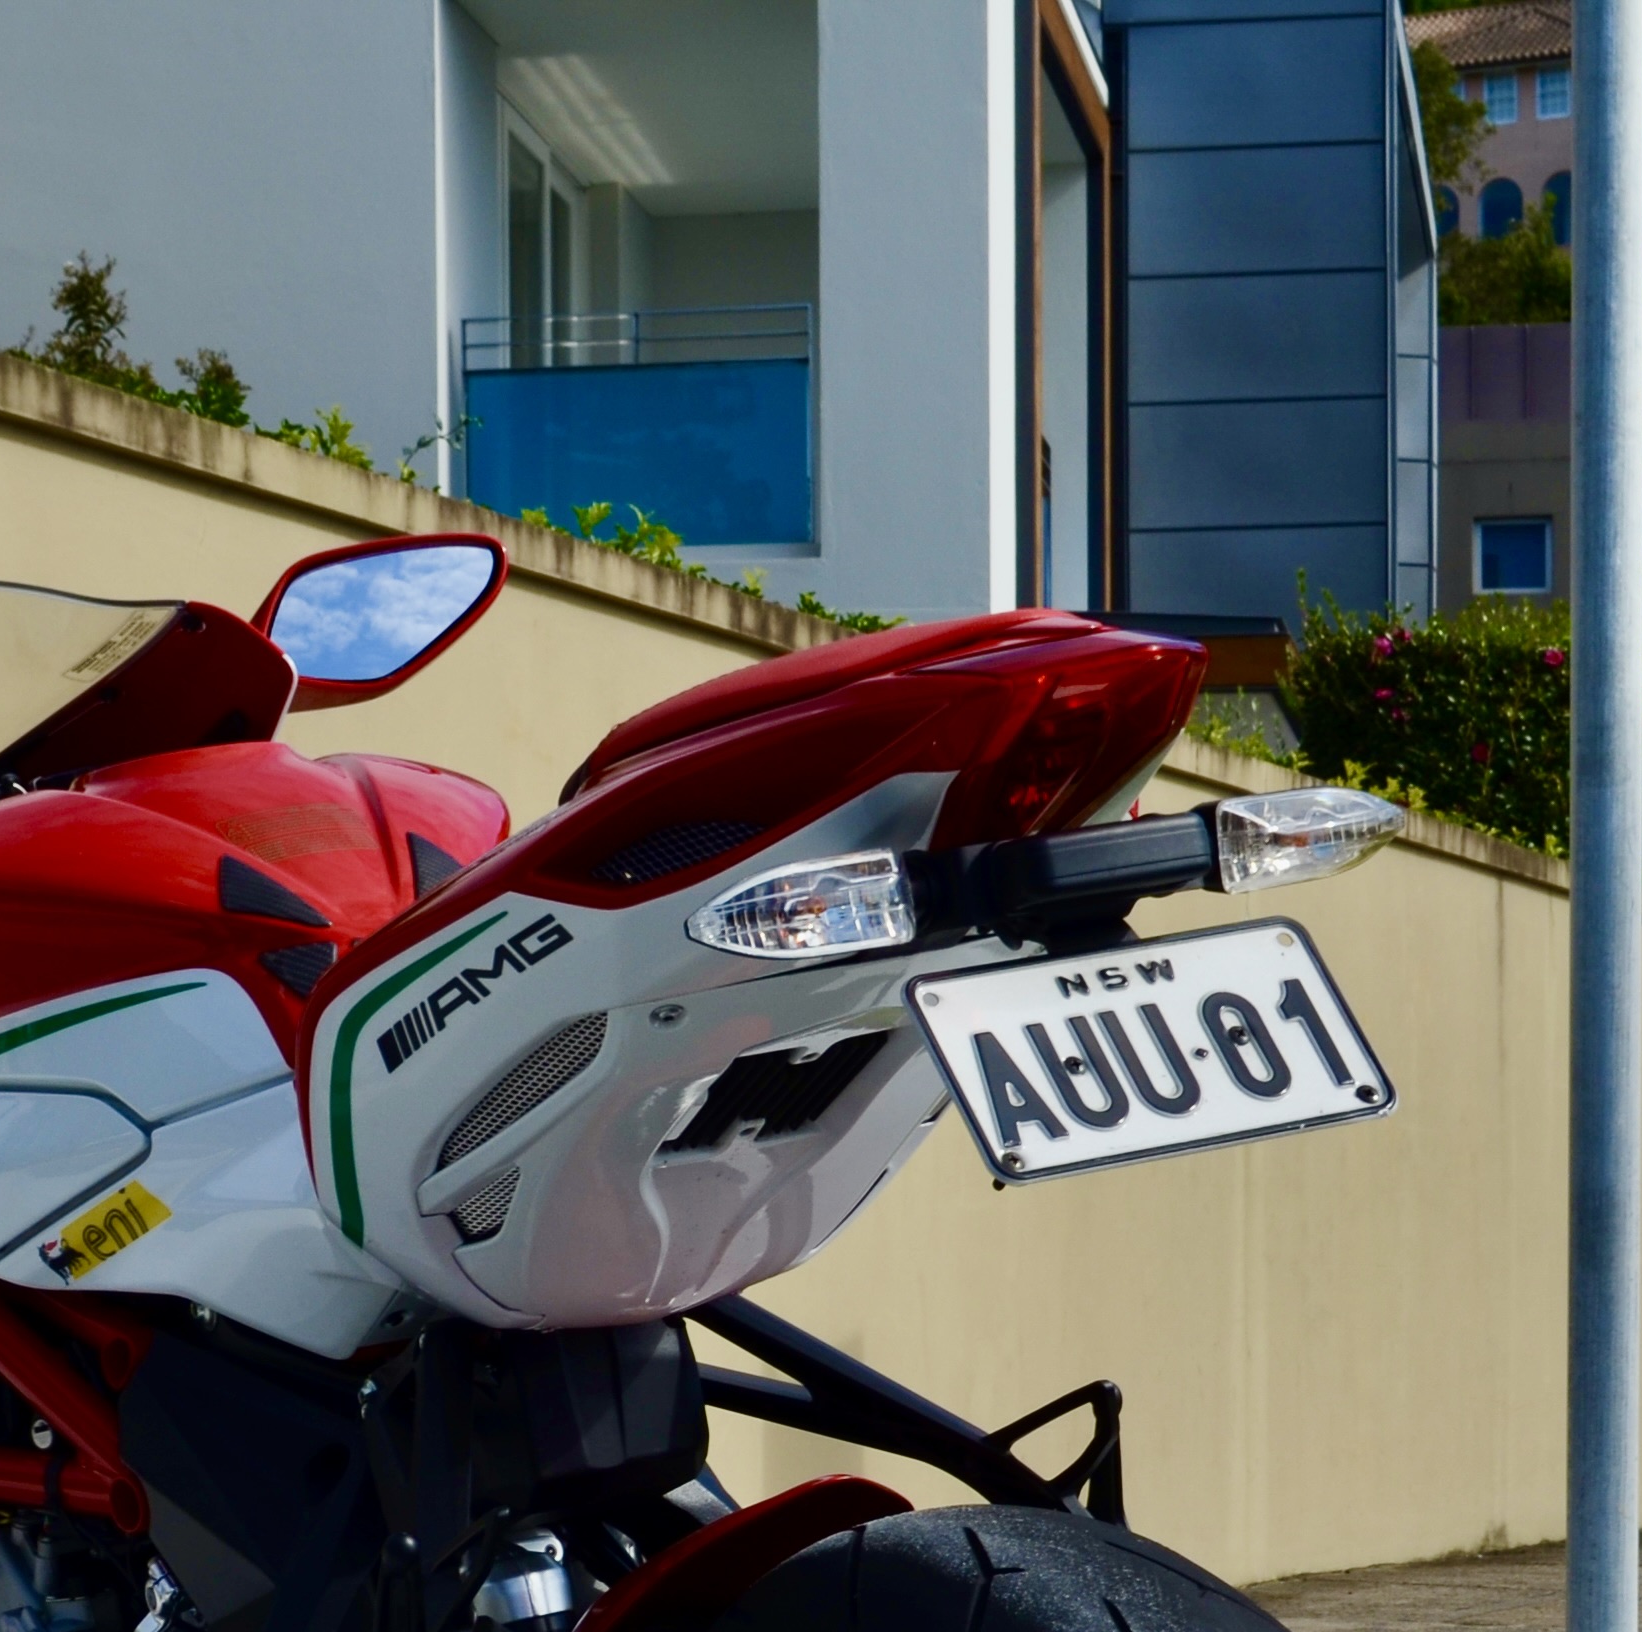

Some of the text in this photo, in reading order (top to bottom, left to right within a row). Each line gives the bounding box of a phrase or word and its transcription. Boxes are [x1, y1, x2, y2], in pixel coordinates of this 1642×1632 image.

[427, 913, 574, 1032] AMG
[1056, 958, 1175, 998] NSW
[82, 1187, 150, 1262] eni
